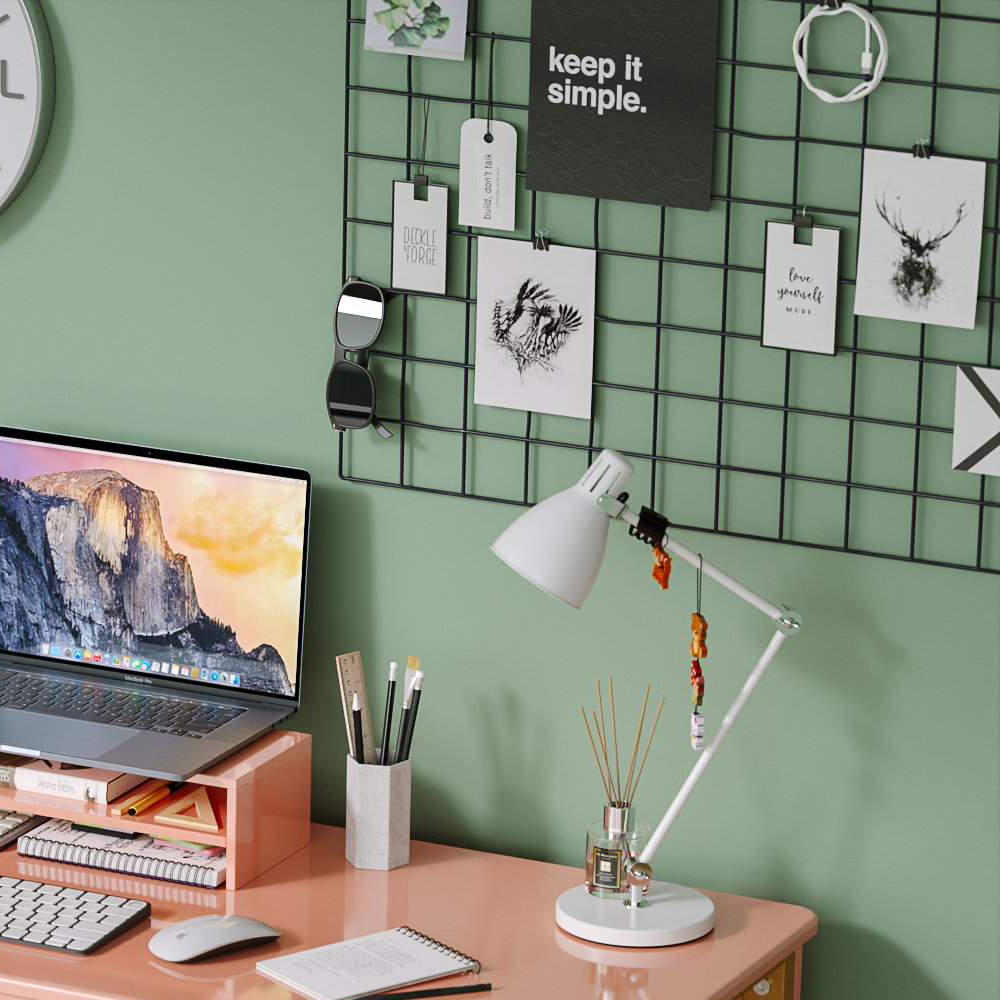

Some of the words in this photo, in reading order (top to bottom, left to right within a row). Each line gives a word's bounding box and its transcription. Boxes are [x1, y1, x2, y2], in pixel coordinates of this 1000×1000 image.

[549, 46, 616, 84] keep
[625, 54, 642, 82] it
[547, 78, 647, 115] simple.
[485, 153, 494, 169] talk
[403, 226, 437, 248] DECKLE
[789, 267, 813, 283] love
[777, 286, 824, 304] yourself
